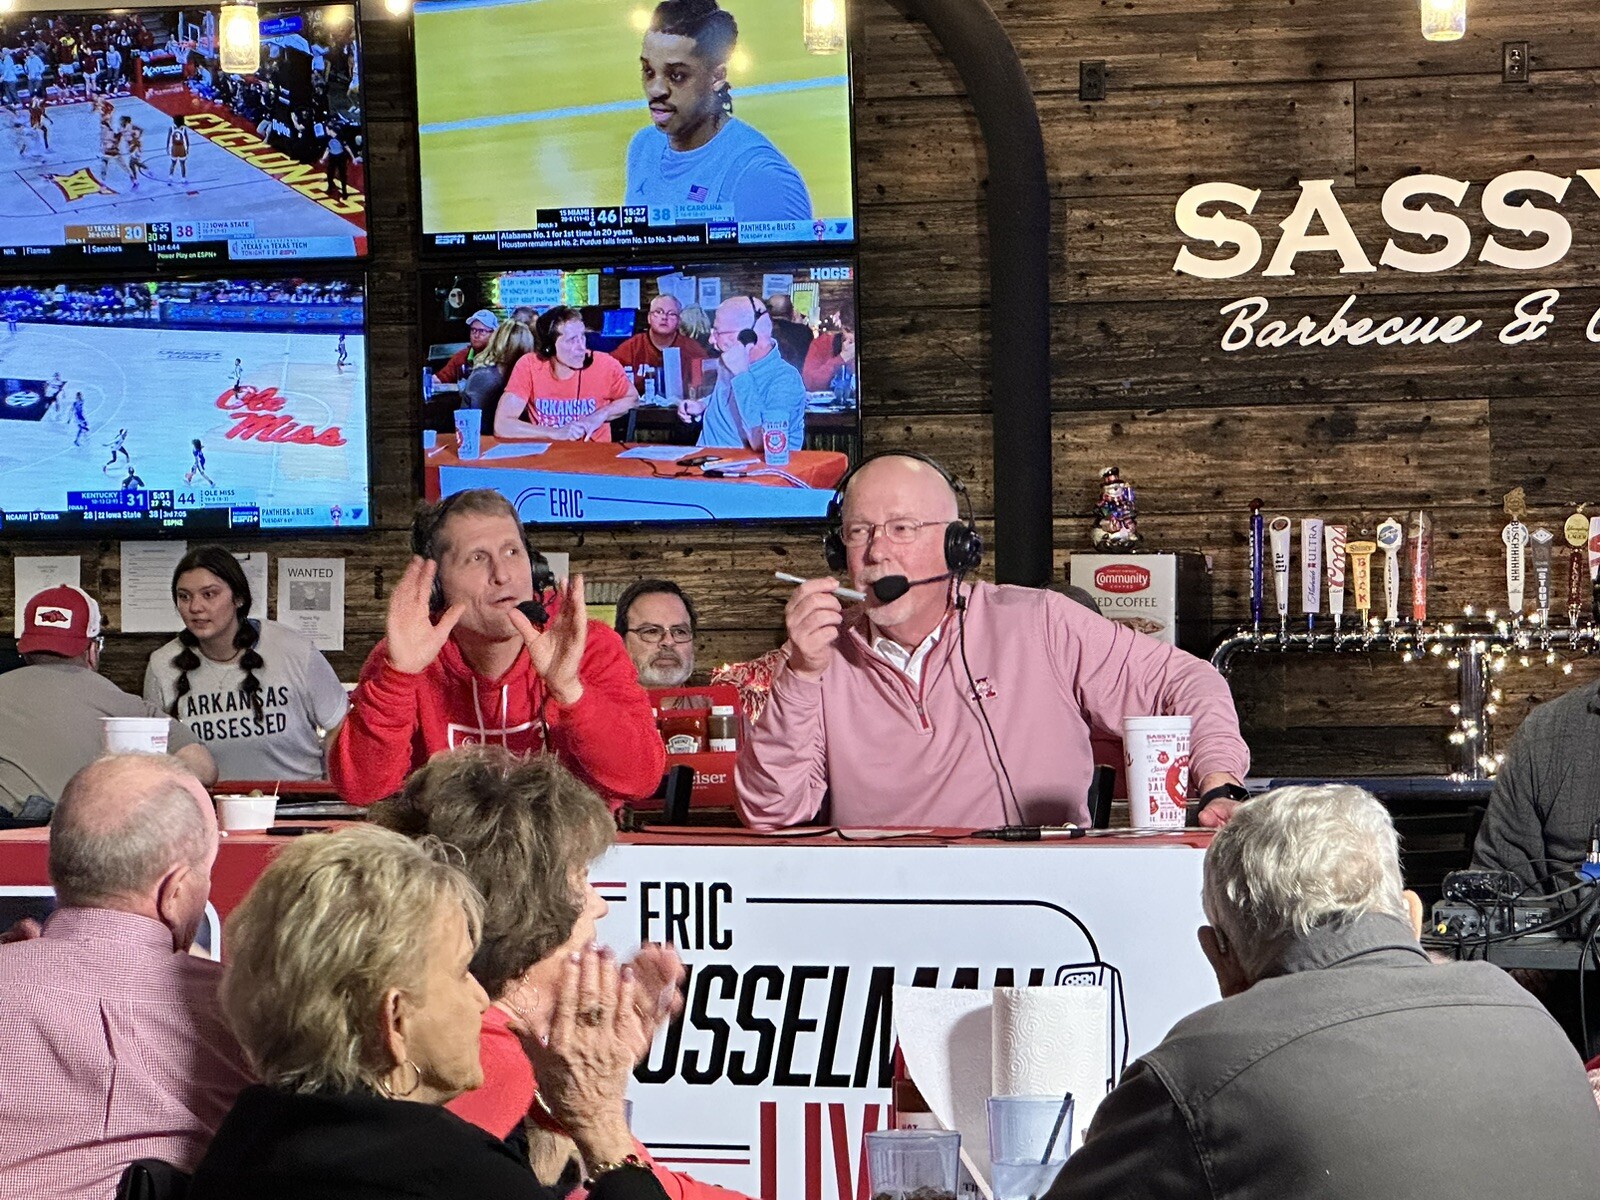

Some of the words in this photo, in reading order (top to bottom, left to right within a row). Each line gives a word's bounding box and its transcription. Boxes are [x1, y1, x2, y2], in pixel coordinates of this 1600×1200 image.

[597, 210, 618, 224] 46
[624, 208, 646, 216] 15:27
[652, 208, 670, 221] 38
[124, 226, 142, 240] 30
[152, 224, 169, 232] 6:25
[176, 225, 193, 238] 38
[613, 229, 633, 237] years
[26, 246, 51, 255] Flames
[92, 245, 122, 254] Senators
[810, 267, 849, 280] HOGS
[1220, 294, 1482, 352] Barbecue
[1499, 289, 1560, 346] &
[225, 412, 348, 448] Miss
[127, 494, 143, 506] 31
[178, 493, 196, 504] 44
[550, 488, 584, 518] ERIC
[1308, 525, 1317, 560] ULTRA
[1276, 553, 1287, 573] Lite
[1327, 525, 1347, 588] Coors
[288, 568, 334, 578] WANTED
[1096, 572, 1148, 586] Community
[1357, 558, 1367, 603] BOCK
[1116, 597, 1157, 607] COFFEE
[188, 686, 288, 717] ARKANSAS
[191, 713, 286, 740] OBSESSED
[640, 882, 732, 950] ERIC
[633, 964, 1045, 1088] USSELM
[760, 1101, 894, 1200] LIV
